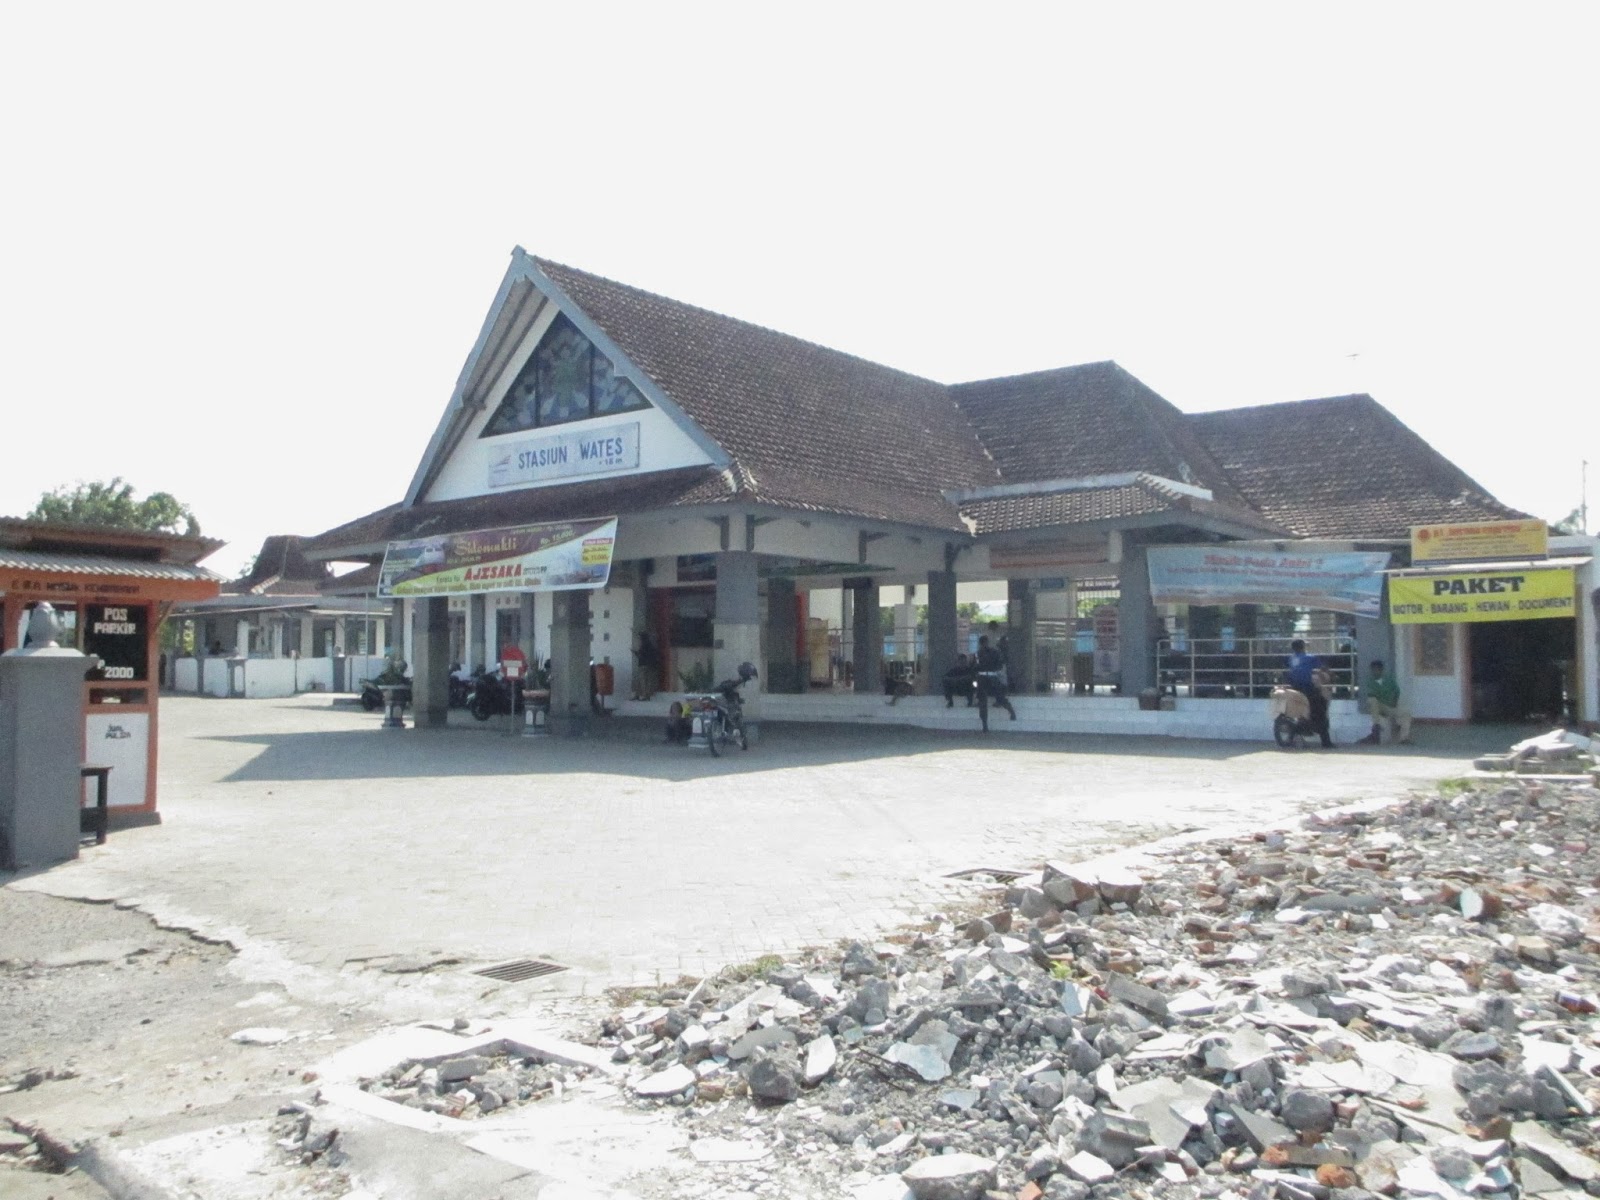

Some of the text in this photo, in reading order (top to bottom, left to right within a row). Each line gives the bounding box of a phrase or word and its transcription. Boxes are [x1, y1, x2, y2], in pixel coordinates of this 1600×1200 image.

[518, 437, 623, 470] STASIUN WATES
[463, 563, 522, 581] AJISAKA
[1433, 575, 1525, 595] PAKET
[104, 607, 128, 621] POS
[1431, 602, 1468, 614] BARANG
[1476, 601, 1510, 612] HEWAN
[1518, 597, 1572, 610] DOCUMENT
[94, 622, 136, 634] PARKIR
[104, 667, 134, 679] 2000
